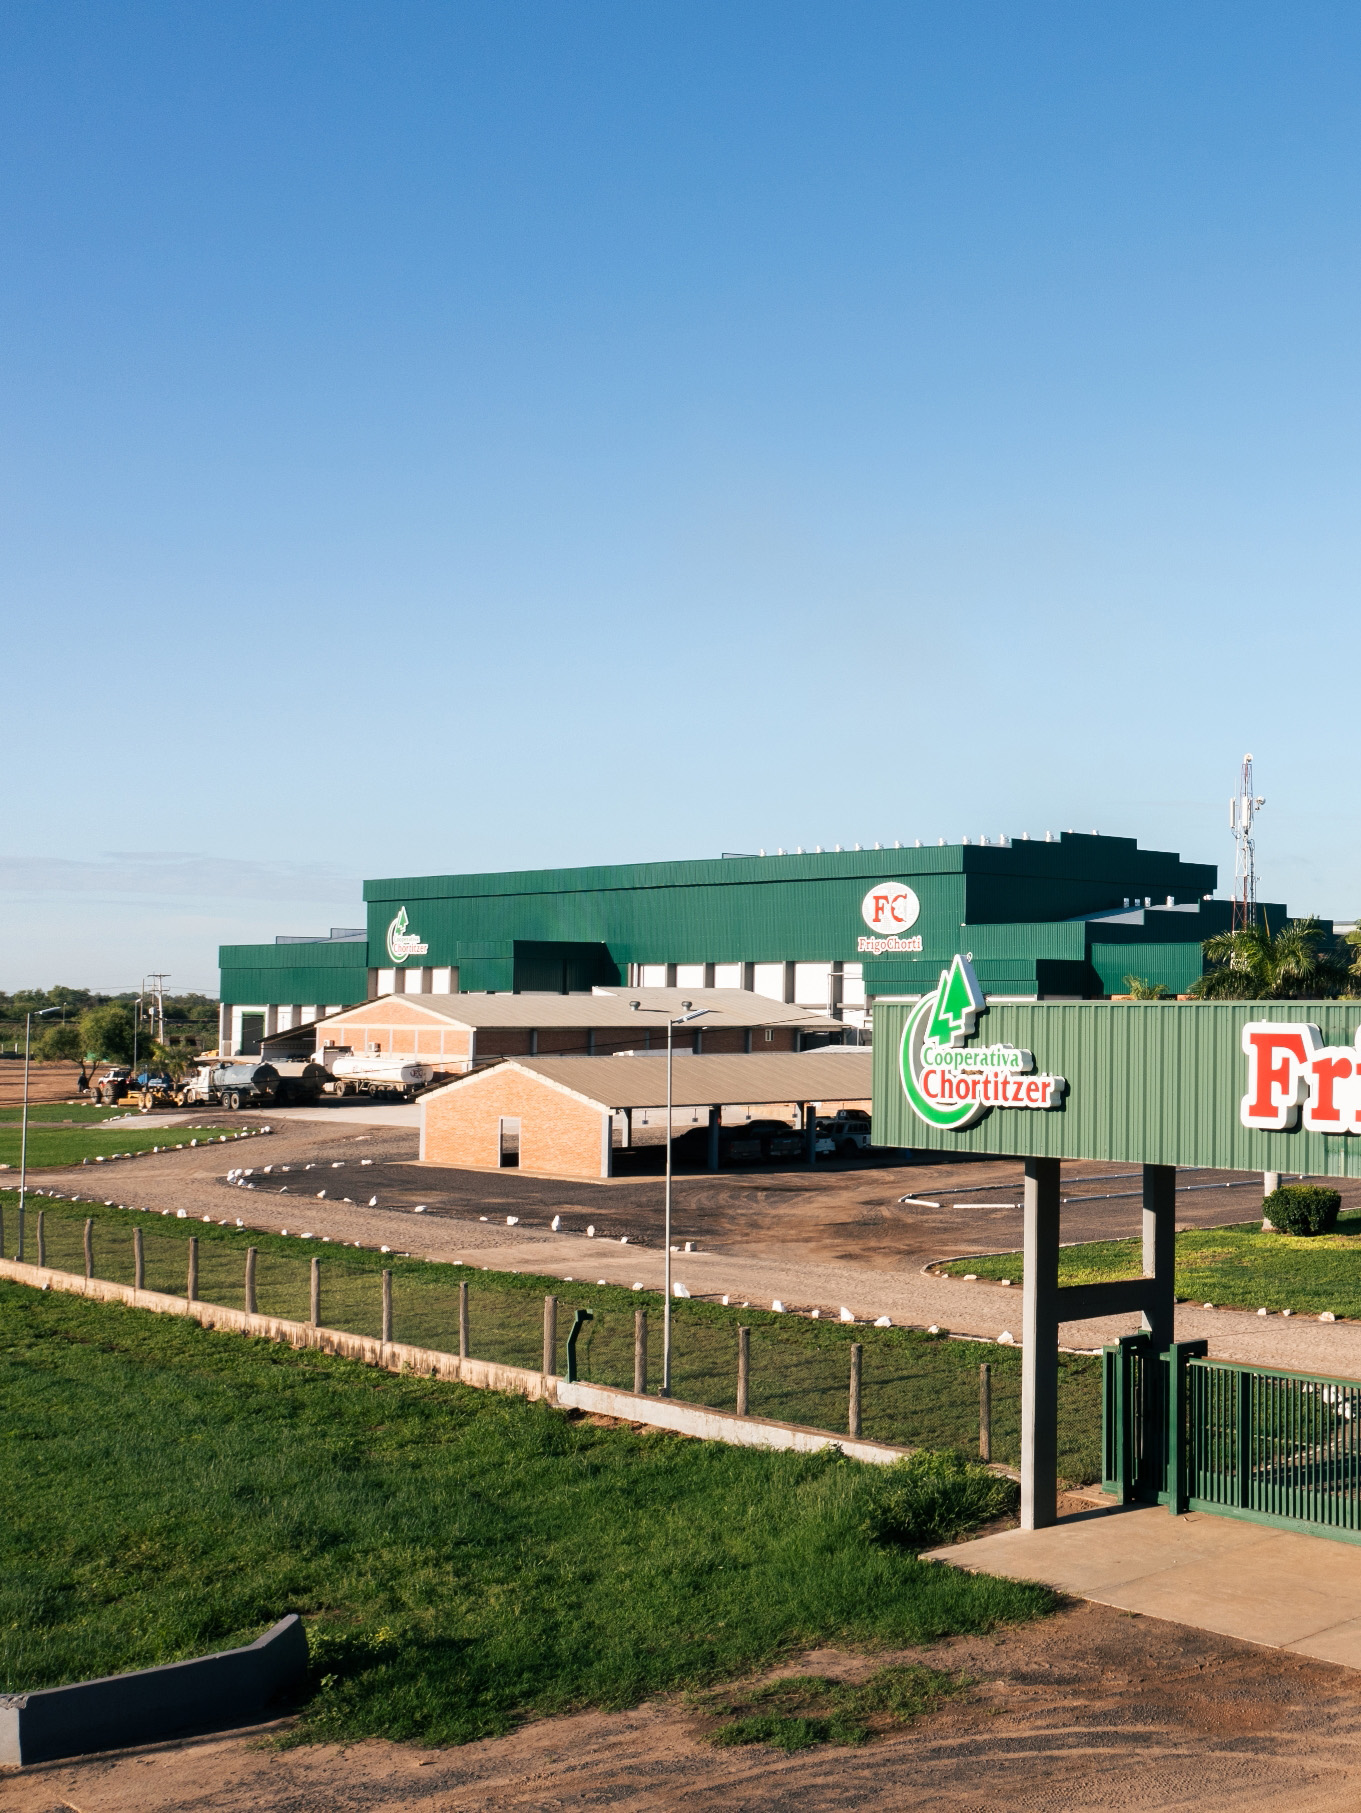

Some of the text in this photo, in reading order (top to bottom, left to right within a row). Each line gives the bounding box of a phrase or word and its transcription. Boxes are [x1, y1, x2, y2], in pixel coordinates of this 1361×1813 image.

[872, 893, 908, 923] FC
[859, 937, 922, 953] FrigoChorti
[923, 1046, 1020, 1071] Cooperativa
[923, 1069, 1051, 1103] Chortitzer
